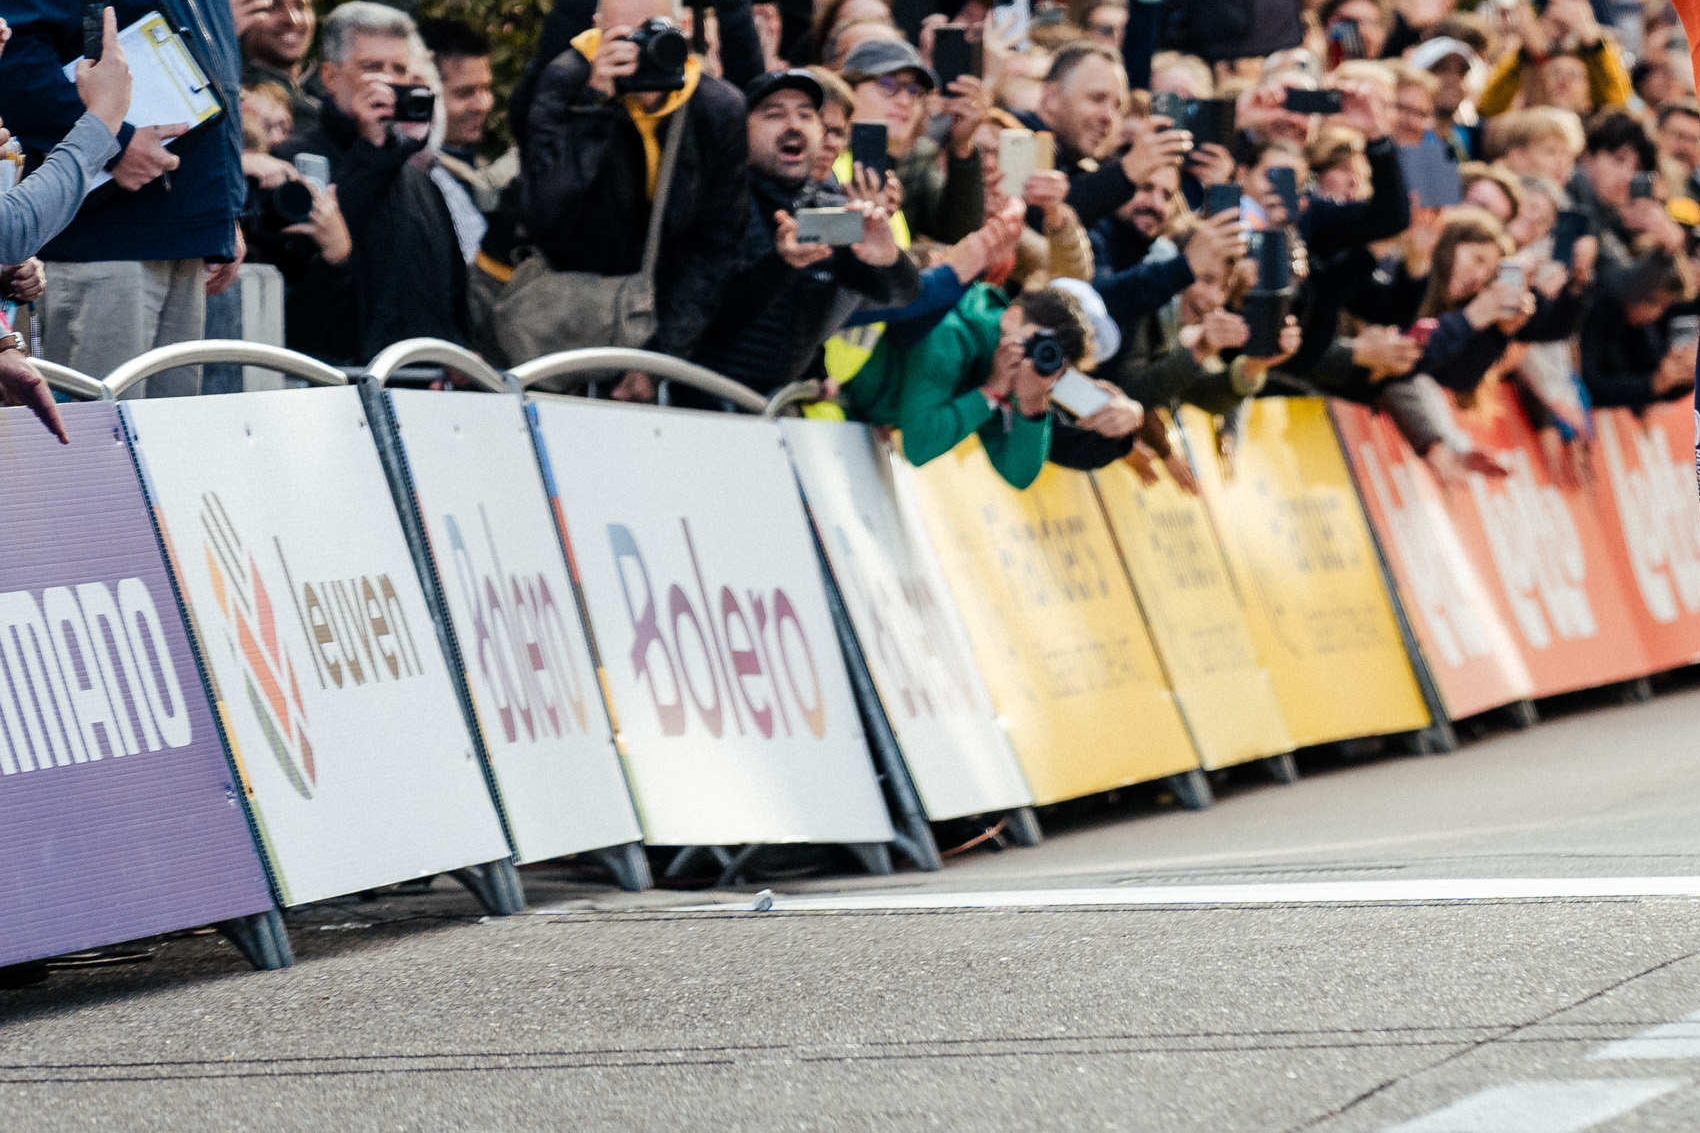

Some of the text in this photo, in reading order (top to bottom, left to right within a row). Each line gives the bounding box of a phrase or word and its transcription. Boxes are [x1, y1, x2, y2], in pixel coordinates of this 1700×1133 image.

[272, 535, 424, 690] leuven
[443, 503, 588, 743] Bolero
[605, 516, 827, 740] Bolero
